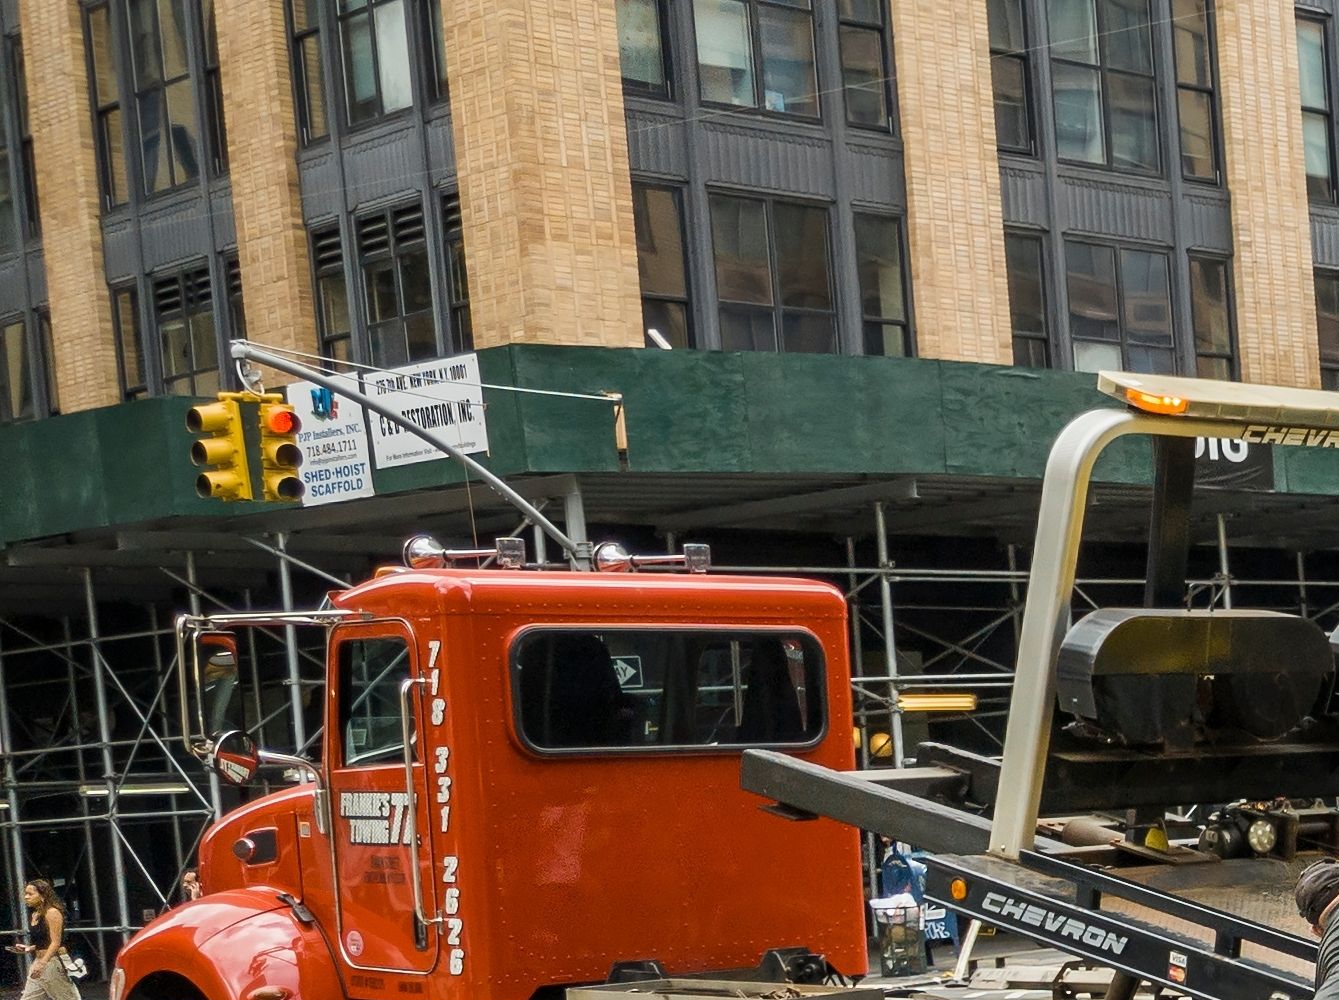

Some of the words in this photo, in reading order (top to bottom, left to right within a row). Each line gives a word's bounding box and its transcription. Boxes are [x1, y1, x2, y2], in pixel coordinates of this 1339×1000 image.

[449, 364, 468, 381] 10001
[345, 423, 361, 434] INC.
[457, 398, 475, 424] INC.
[311, 479, 363, 498] SCAFFOLD
[428, 640, 446, 726] 718
[434, 746, 452, 833] 331
[442, 856, 465, 976] 2626
[981, 892, 1129, 956] CHEVRON
